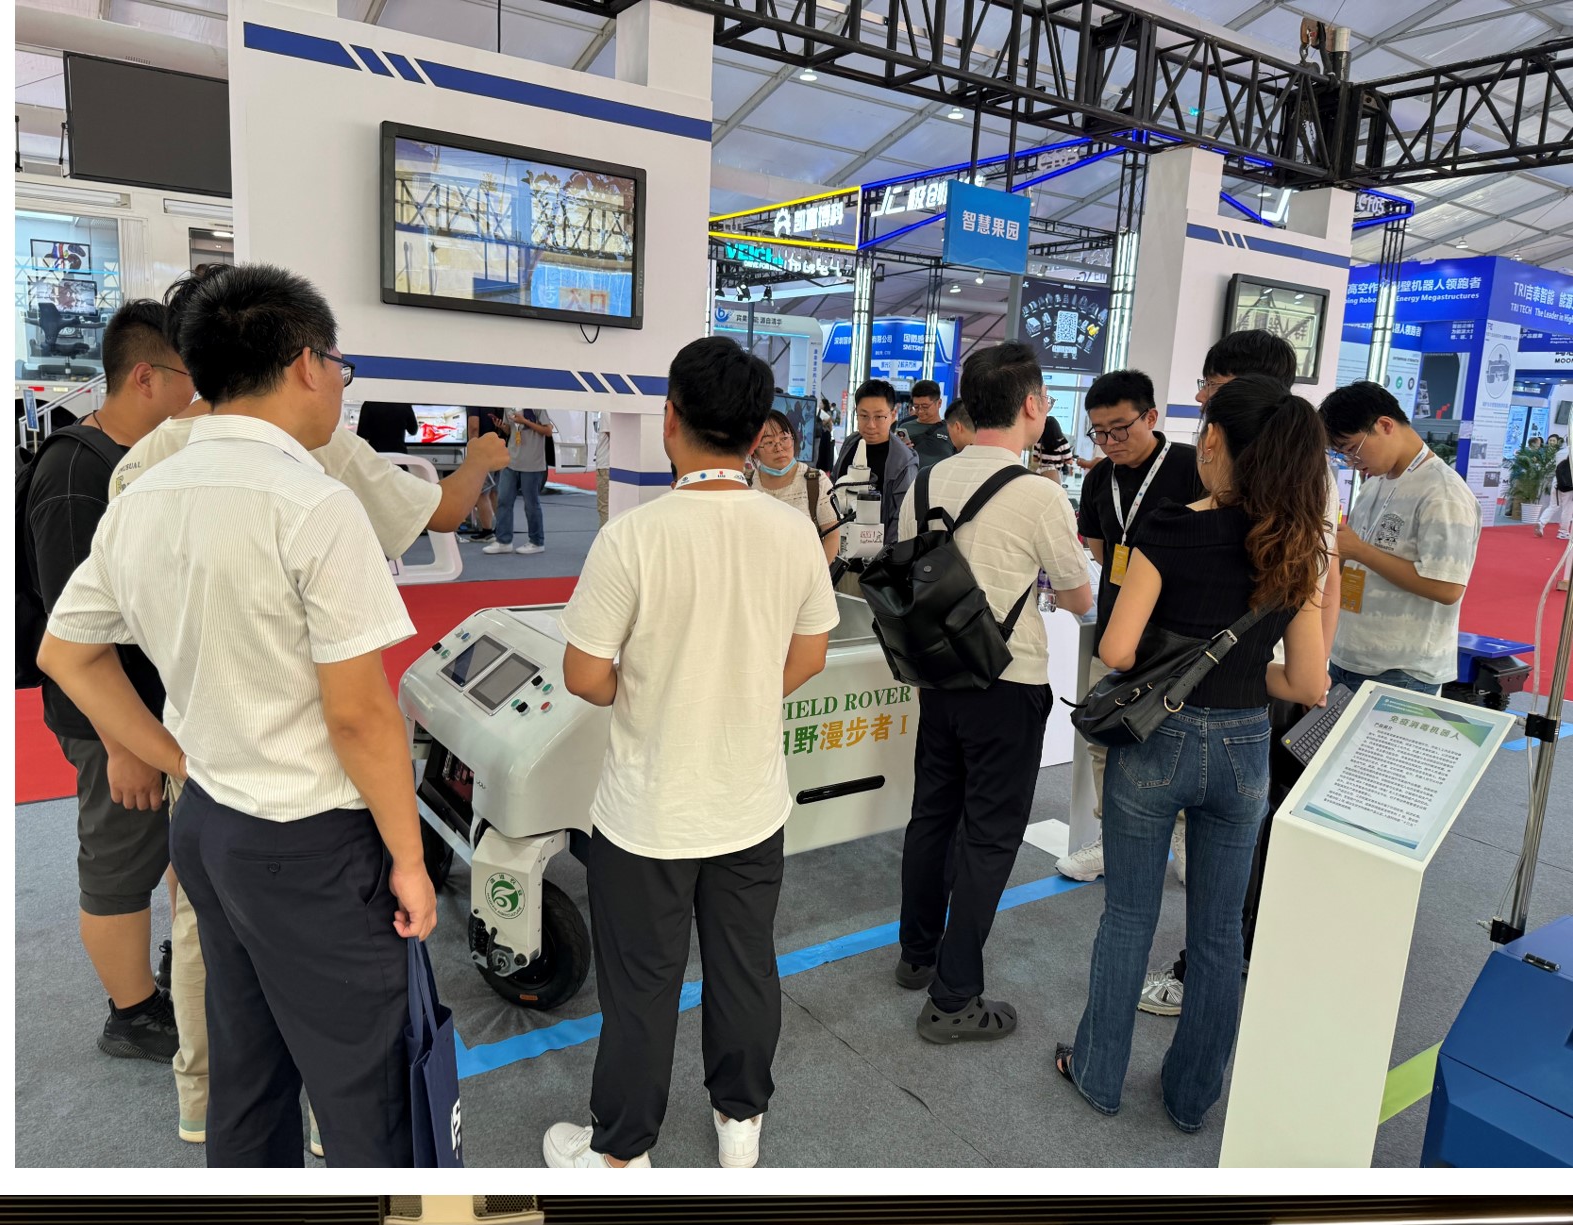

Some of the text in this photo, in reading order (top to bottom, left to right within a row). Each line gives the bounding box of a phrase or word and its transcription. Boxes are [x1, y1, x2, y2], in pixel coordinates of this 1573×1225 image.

[962, 209, 1020, 241] 智慧果园
[1347, 276, 1481, 295] 高空作壁机器人领跑者
[1359, 295, 1377, 303] Robo
[1396, 294, 1420, 303] Energy
[1421, 292, 1480, 301] Megastructures
[844, 685, 912, 712] ROVER
[1389, 714, 1461, 741] 免疫消毒机器人
